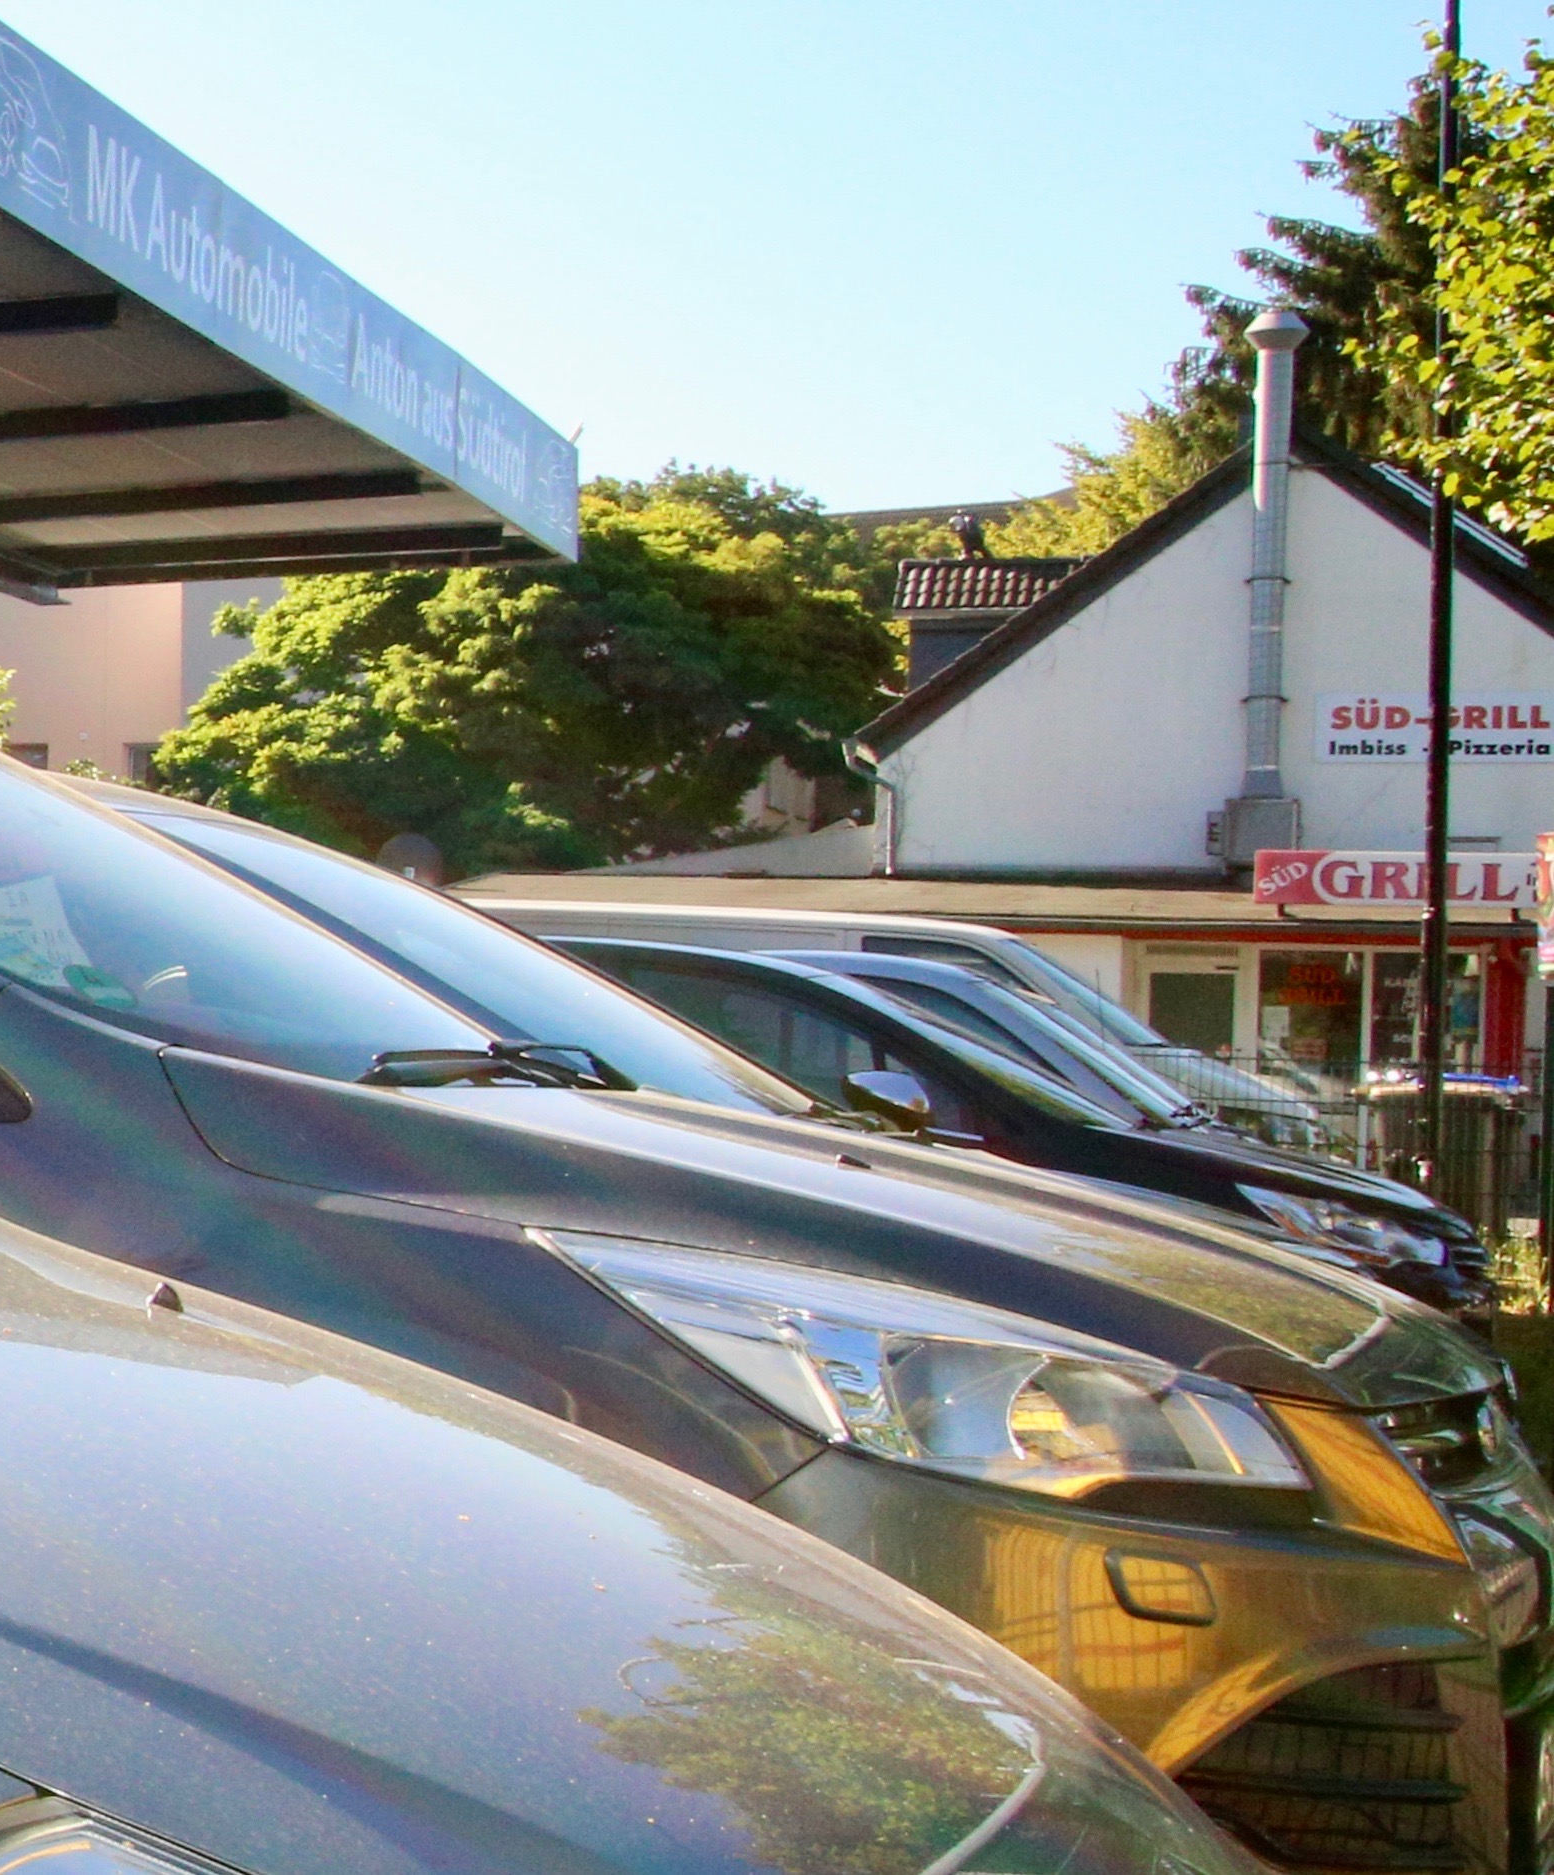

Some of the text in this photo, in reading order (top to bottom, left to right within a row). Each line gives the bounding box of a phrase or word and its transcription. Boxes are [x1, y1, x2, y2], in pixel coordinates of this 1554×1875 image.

[87, 124, 142, 252] MK
[145, 172, 310, 362] Automobile
[350, 313, 419, 430] Anton
[456, 387, 528, 503] Südtirol
[1329, 739, 1407, 755] Imbiss
[1449, 739, 1551, 755] Pizzeria
[1259, 861, 1308, 896] SÜD
